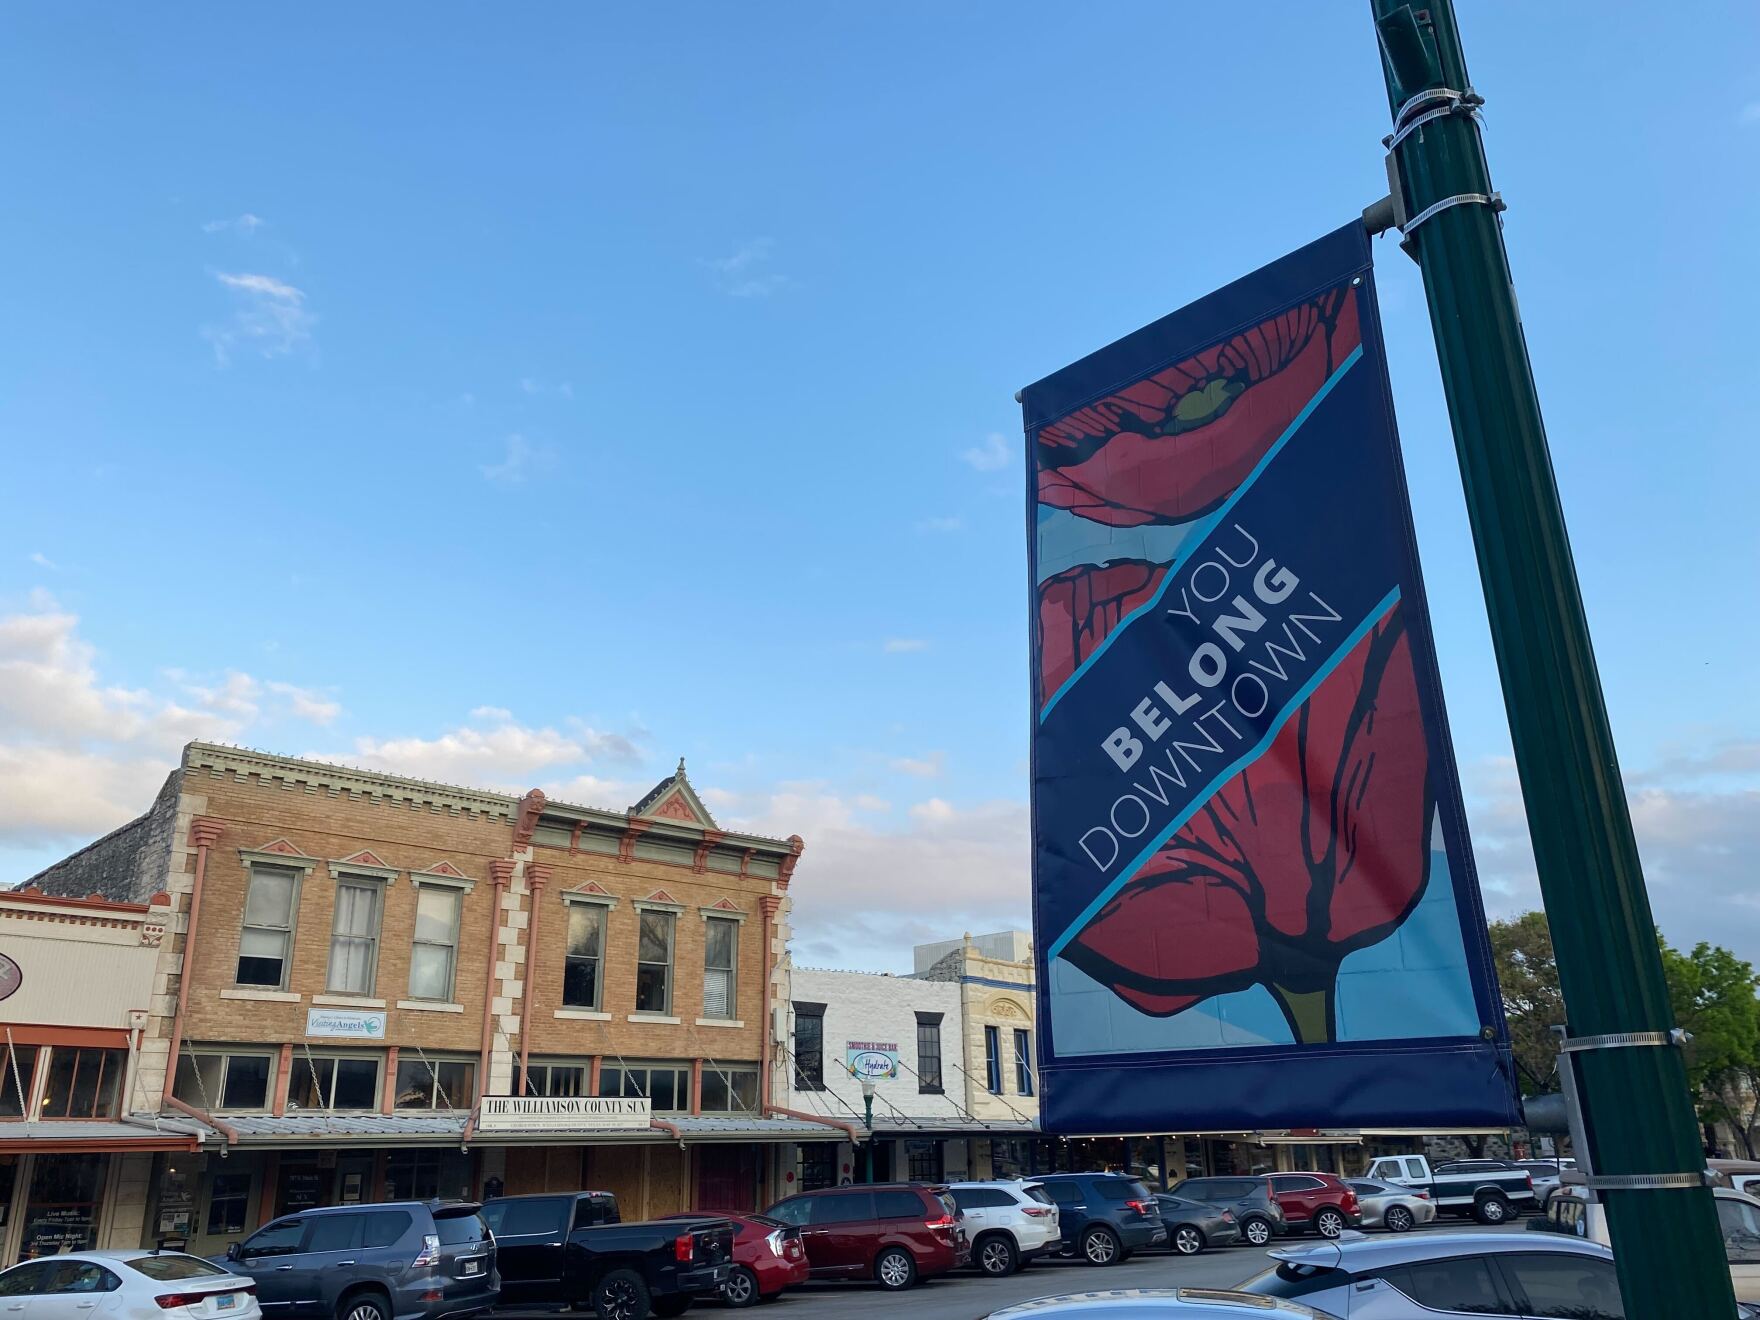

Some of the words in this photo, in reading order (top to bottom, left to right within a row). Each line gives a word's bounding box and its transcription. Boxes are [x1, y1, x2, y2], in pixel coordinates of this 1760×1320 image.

[1167, 523, 1259, 625] YOU
[1100, 558, 1300, 773] BELONG
[1078, 591, 1342, 872] DOWNTOWN
[337, 1020, 365, 1029] Angels
[864, 1058, 889, 1075] Hydrate
[486, 1100, 509, 1114] THE
[513, 1100, 580, 1114] WILLIAMSON
[584, 1100, 624, 1114] COUNTY
[627, 1100, 646, 1114] SUN
